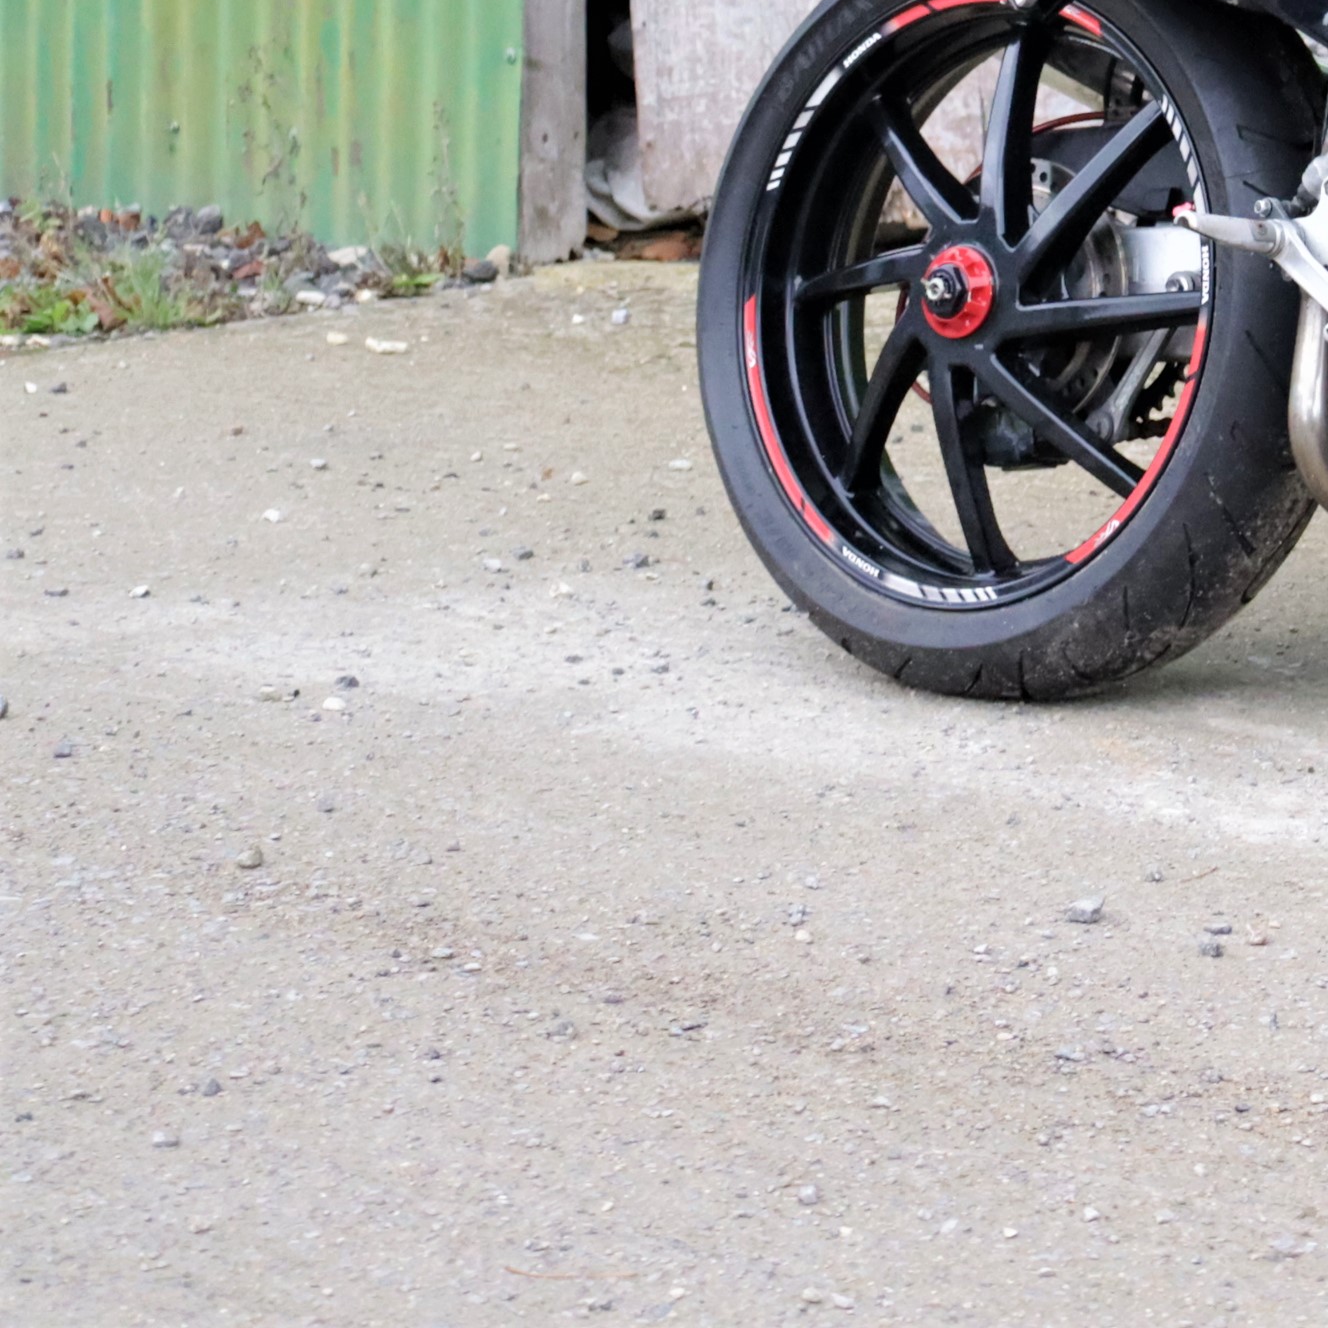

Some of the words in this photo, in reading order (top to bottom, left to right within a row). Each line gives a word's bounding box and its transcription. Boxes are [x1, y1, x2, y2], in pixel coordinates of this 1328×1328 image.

[843, 33, 881, 69] HONDA
[1201, 245, 1210, 305] HONDA
[842, 546, 880, 578] HONDA
